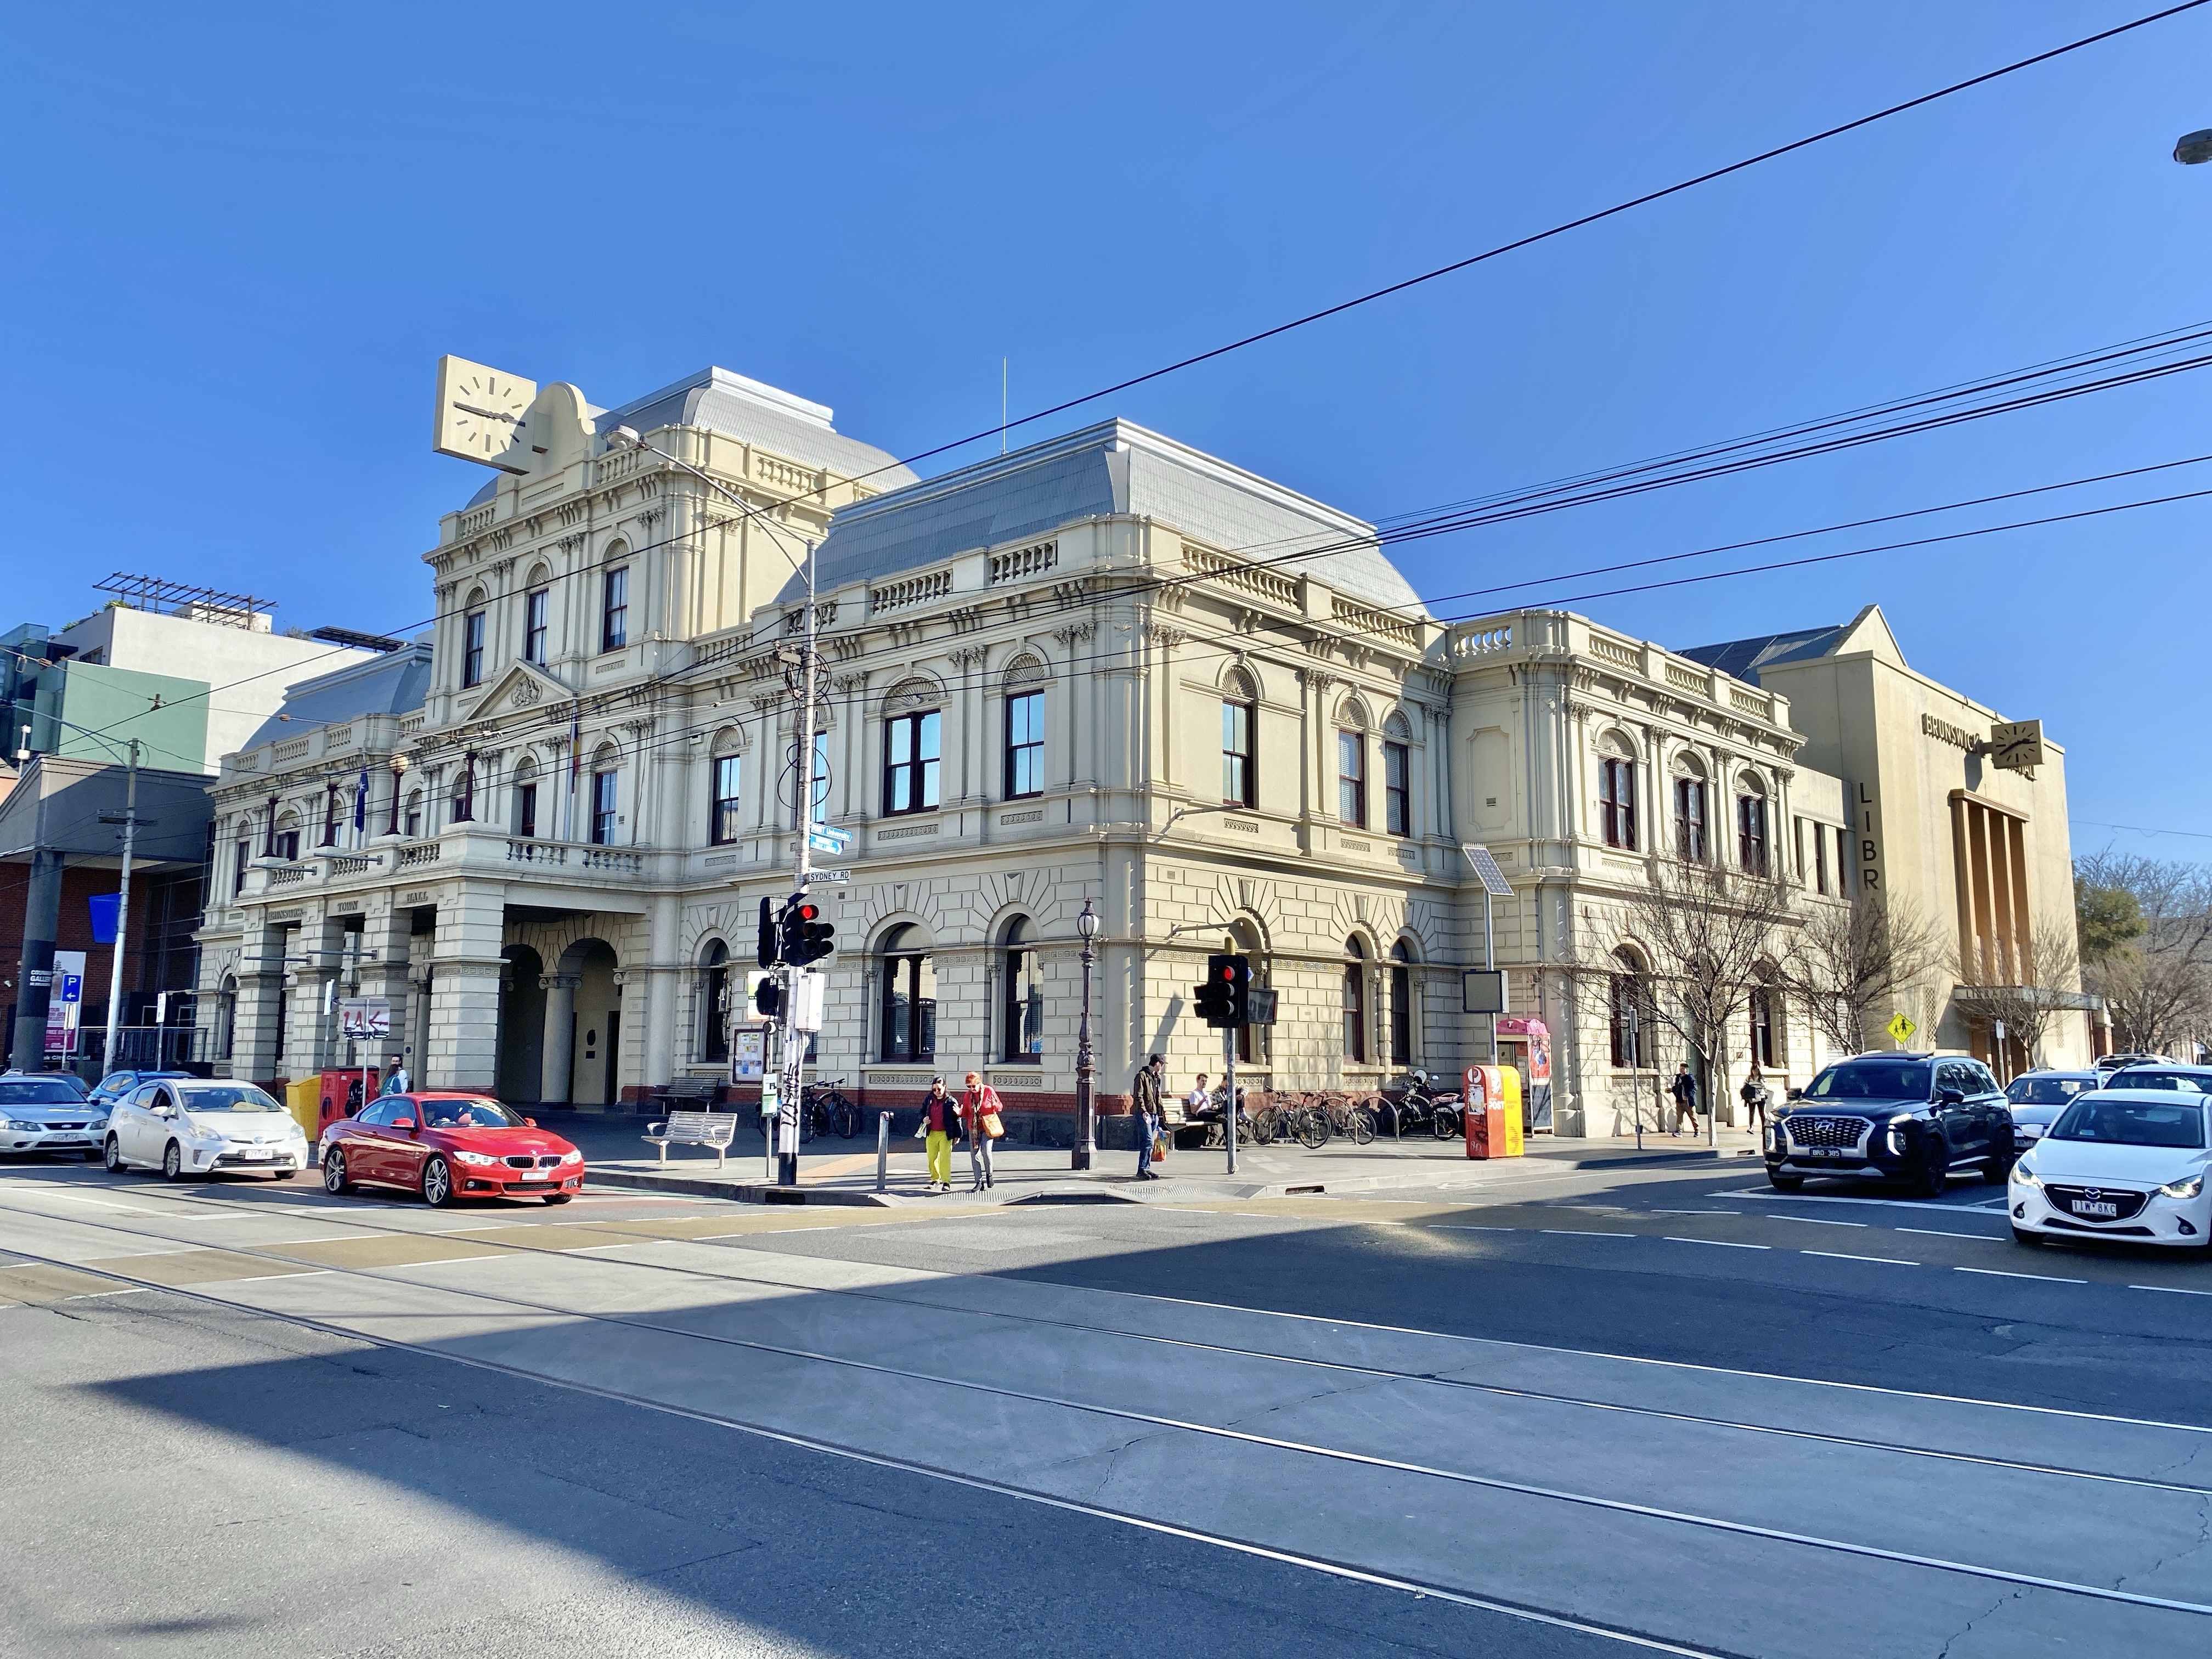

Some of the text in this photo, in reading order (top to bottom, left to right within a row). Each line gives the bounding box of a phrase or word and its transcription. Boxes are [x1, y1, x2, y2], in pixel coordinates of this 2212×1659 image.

[811, 872, 837, 881] SYDNEY
[268, 891, 428, 920] BRUNSWICK TOWN HALL
[68, 977, 77, 986] P
[1488, 1101, 1504, 1110] POST
[2074, 1200, 2116, 1214] 1IW 8KC
